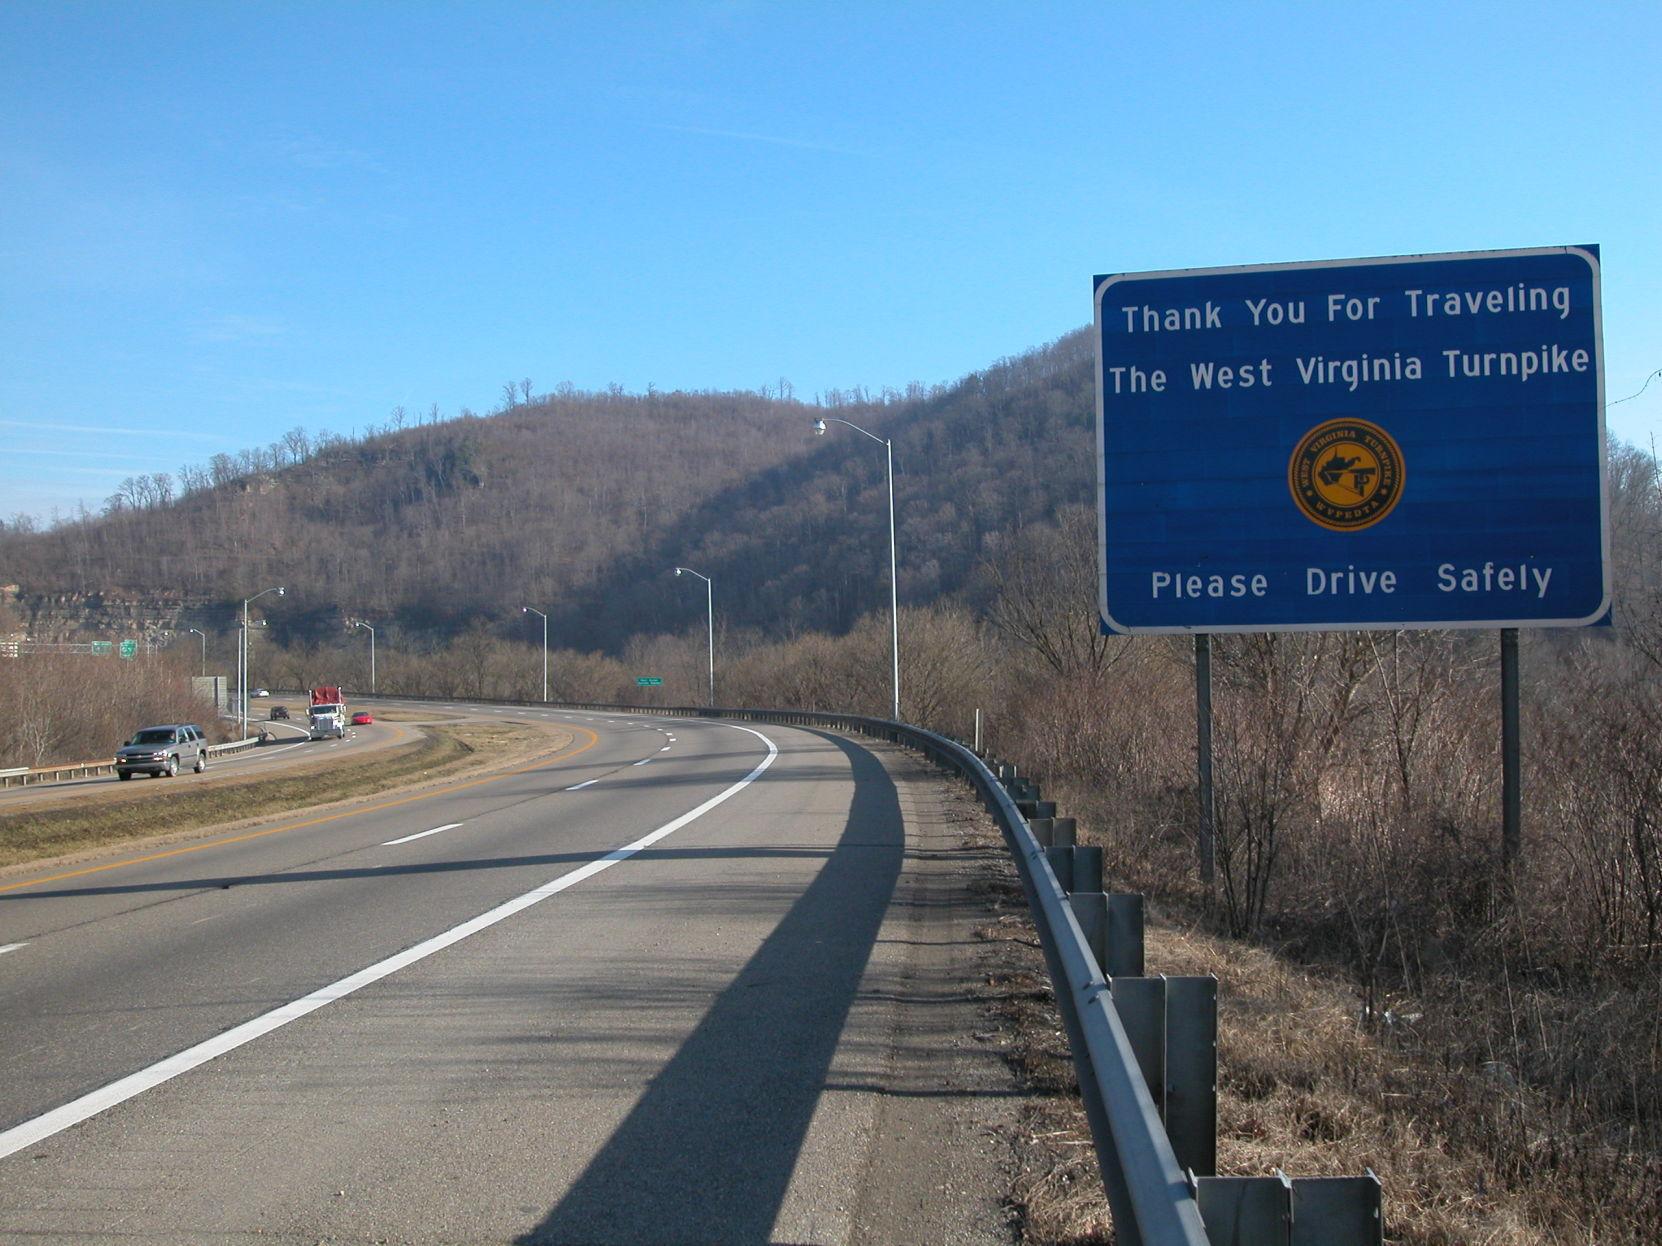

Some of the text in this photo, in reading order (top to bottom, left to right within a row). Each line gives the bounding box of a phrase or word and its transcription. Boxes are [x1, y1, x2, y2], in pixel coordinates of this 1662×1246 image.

[1122, 282, 1570, 333] Thank You For Traveling
[1109, 343, 1590, 393] The West Virginia Turnpike
[1301, 430, 1391, 487] WEST VIRGINIA TURNPIKE
[1152, 561, 1553, 598] Please Drive Safely
